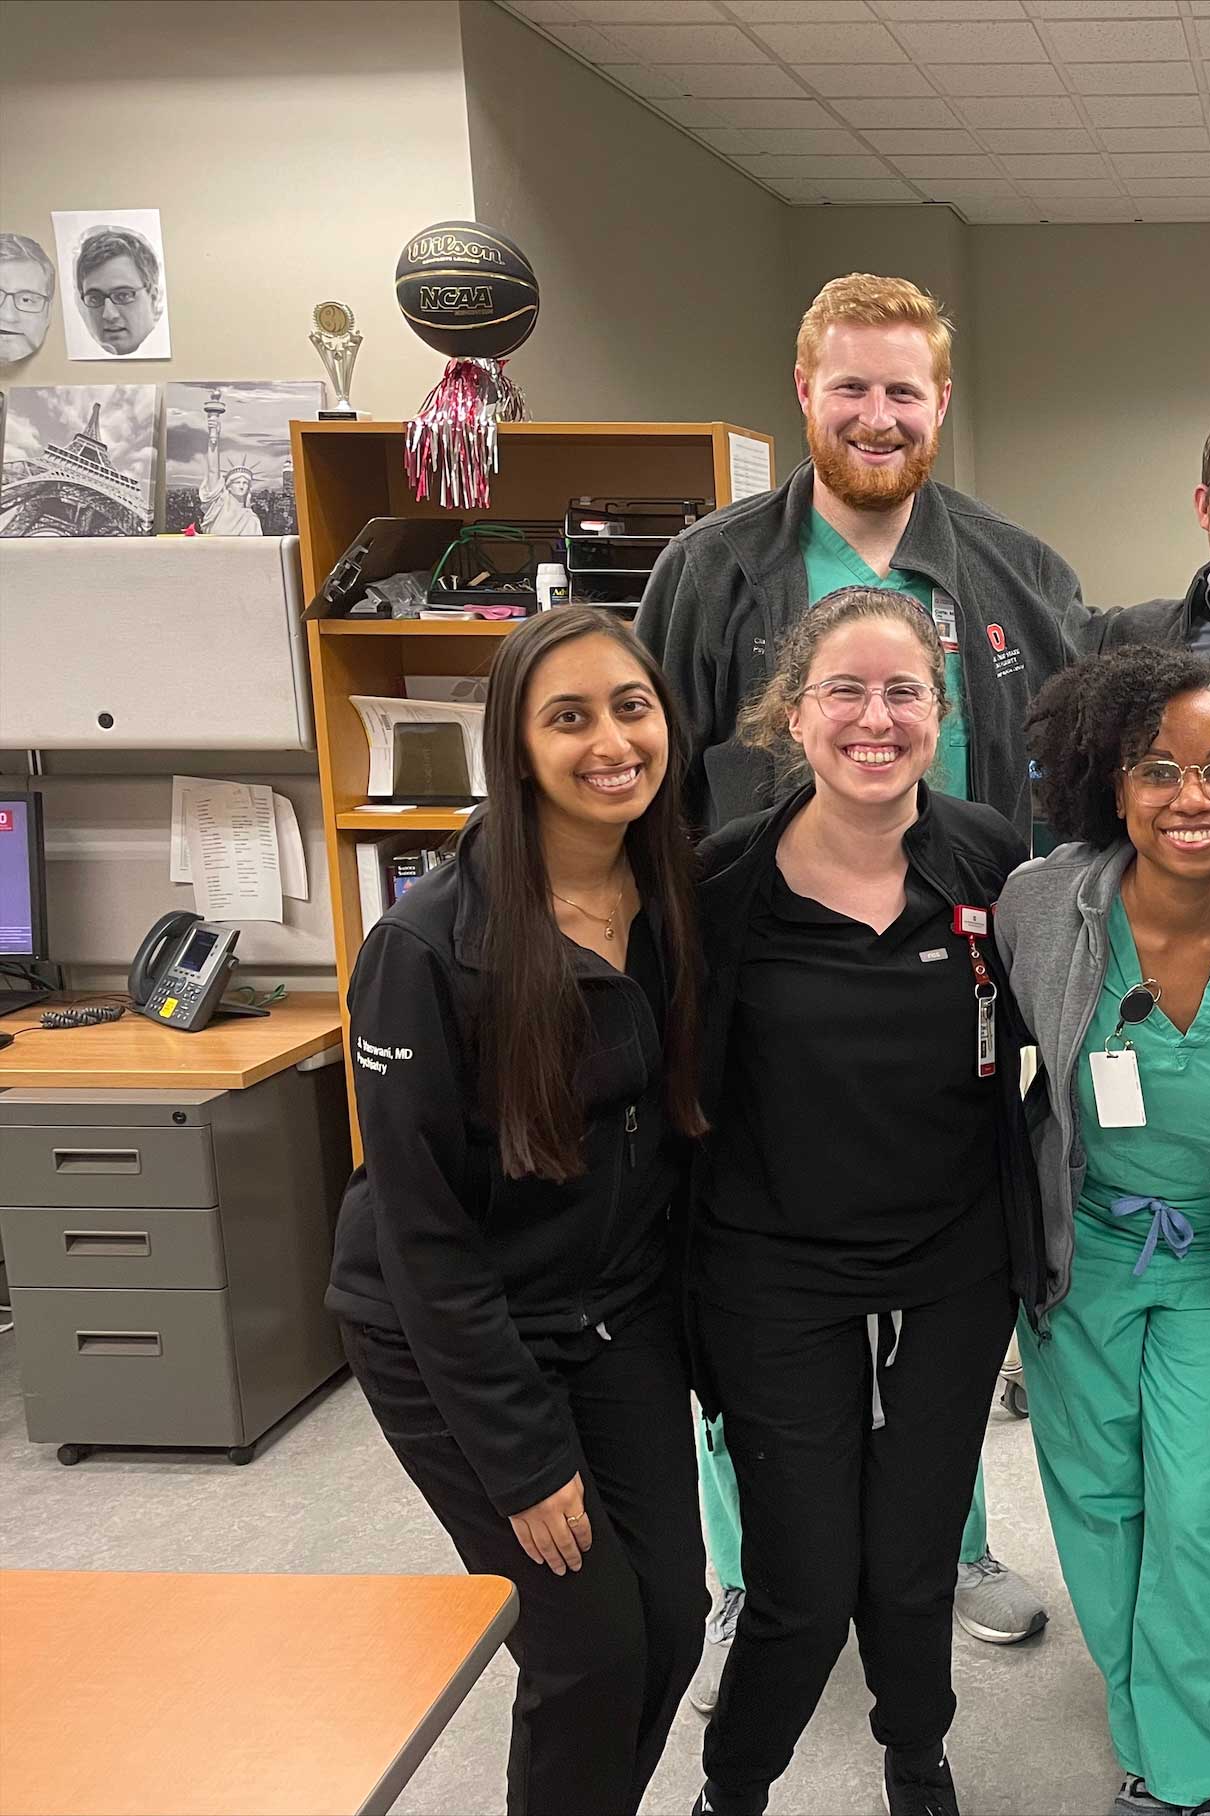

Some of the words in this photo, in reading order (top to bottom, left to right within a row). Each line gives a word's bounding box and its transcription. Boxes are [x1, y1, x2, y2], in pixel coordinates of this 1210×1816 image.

[408, 234, 502, 264] Wilson
[419, 286, 493, 310] NCAA
[395, 1047, 413, 1060] MD
